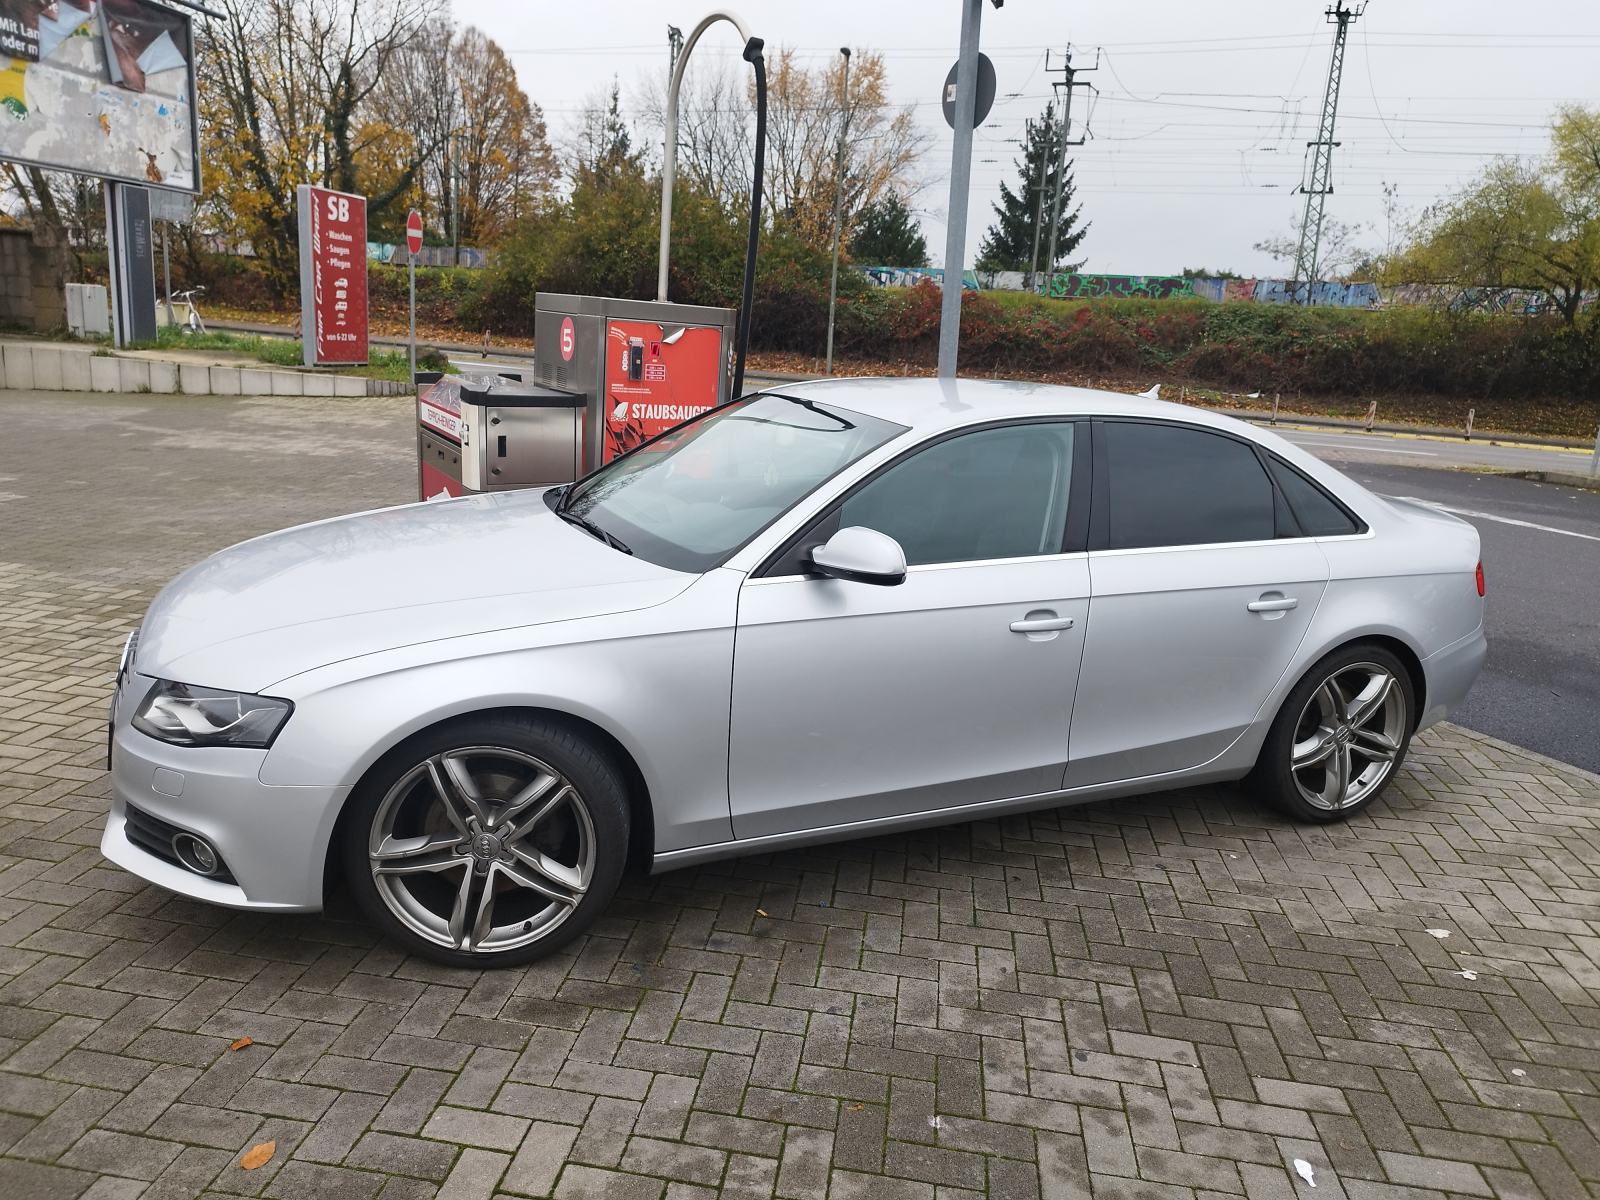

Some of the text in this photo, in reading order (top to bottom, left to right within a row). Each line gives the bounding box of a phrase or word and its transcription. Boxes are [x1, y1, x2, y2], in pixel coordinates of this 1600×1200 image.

[0, 17, 40, 40] Mit Lan
[2, 36, 26, 52] oder
[328, 196, 350, 223] SB
[329, 230, 352, 242] Waschen
[330, 244, 350, 256] Saugen
[330, 258, 351, 270] Pflegen
[326, 333, 337, 341] von
[347, 332, 357, 342] Uhr
[563, 328, 573, 352] 5
